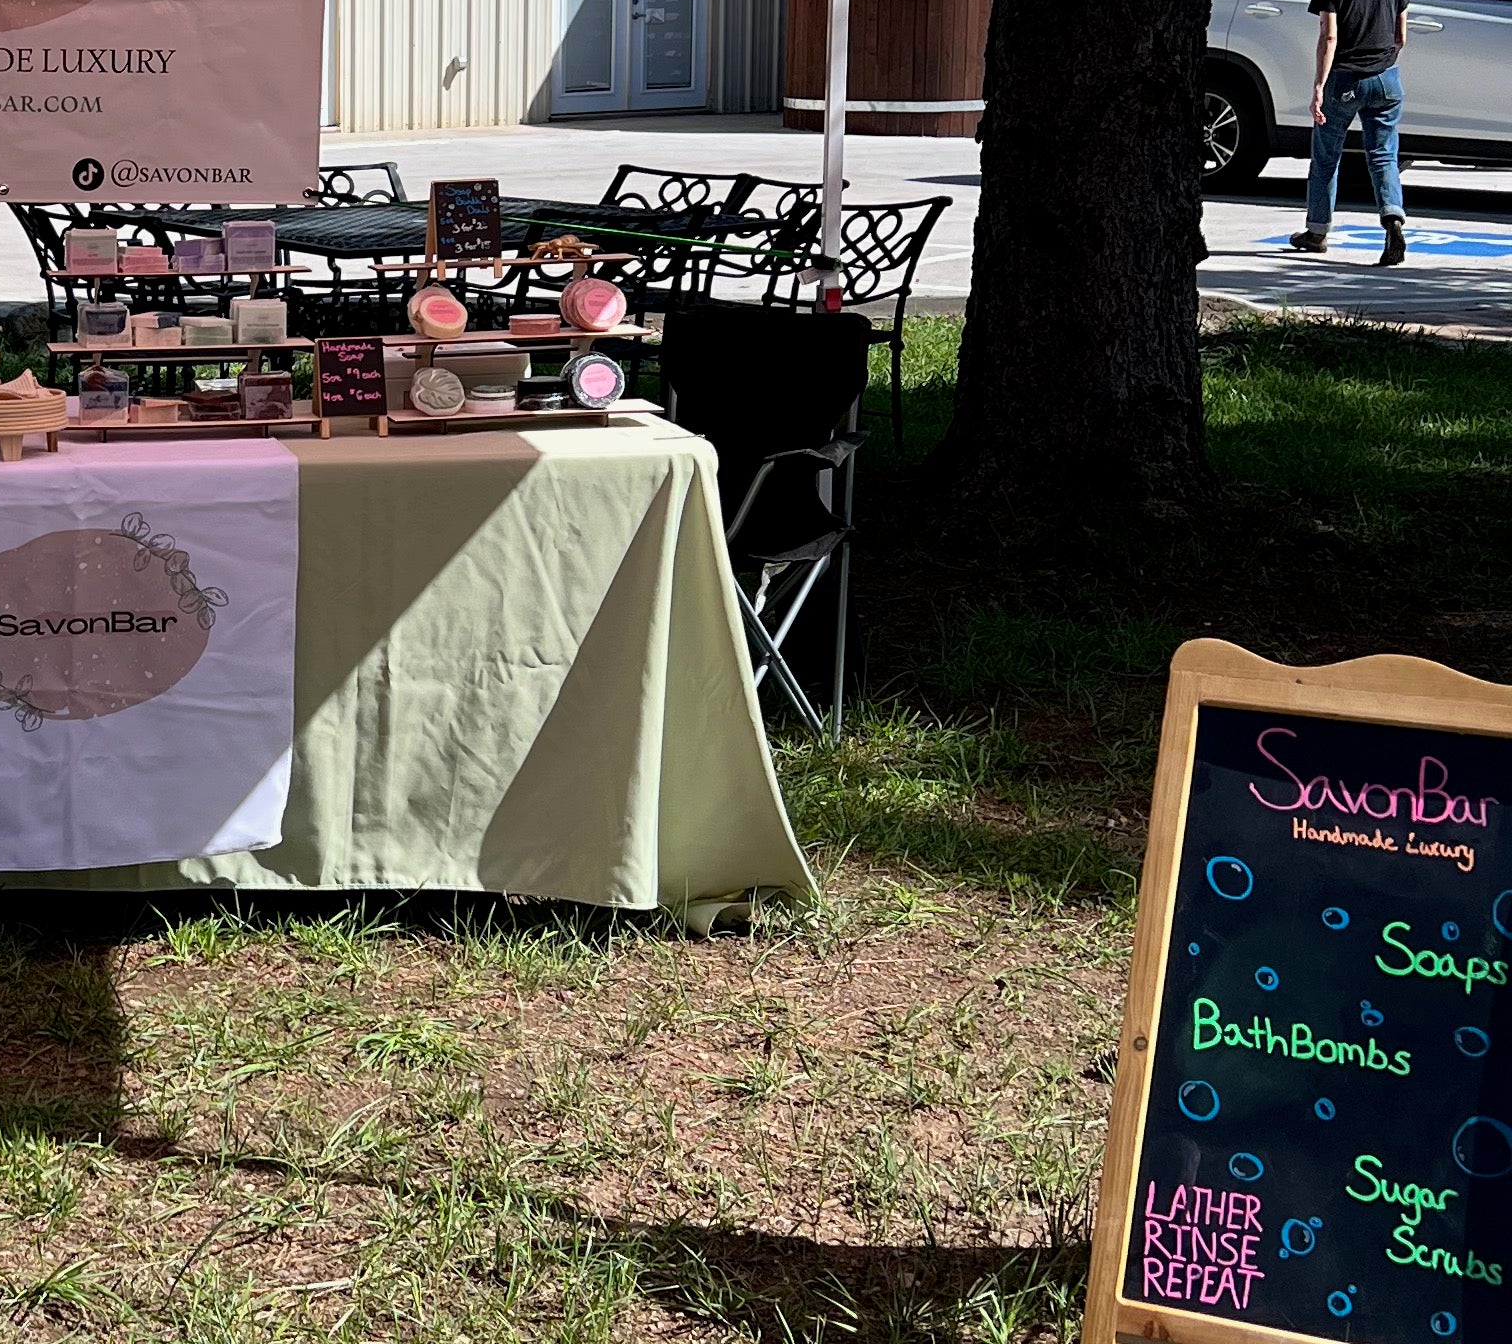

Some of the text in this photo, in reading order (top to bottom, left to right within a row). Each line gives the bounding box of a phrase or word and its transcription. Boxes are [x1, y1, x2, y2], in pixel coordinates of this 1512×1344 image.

[41, 48, 177, 75] LUXURY
[111, 159, 254, 188] @SAVONBAR
[454, 243, 464, 254] 3
[322, 341, 375, 353] Handmade
[338, 351, 364, 362] Soap
[322, 372, 343, 383] 5oz
[361, 369, 382, 380] each
[322, 391, 344, 402] 4oz
[363, 390, 382, 400] each
[1249, 727, 1500, 828] SavonBar
[1292, 816, 1475, 873] Handmade Luxury
[1374, 921, 1509, 995] Soaps
[1145, 1180, 1263, 1233] LATHER
[1345, 1155, 1460, 1226] Sugar
[1144, 1220, 1261, 1270] RINSE
[1386, 1225, 1503, 1286] Scrubs
[1143, 1257, 1266, 1311] REPEAT
